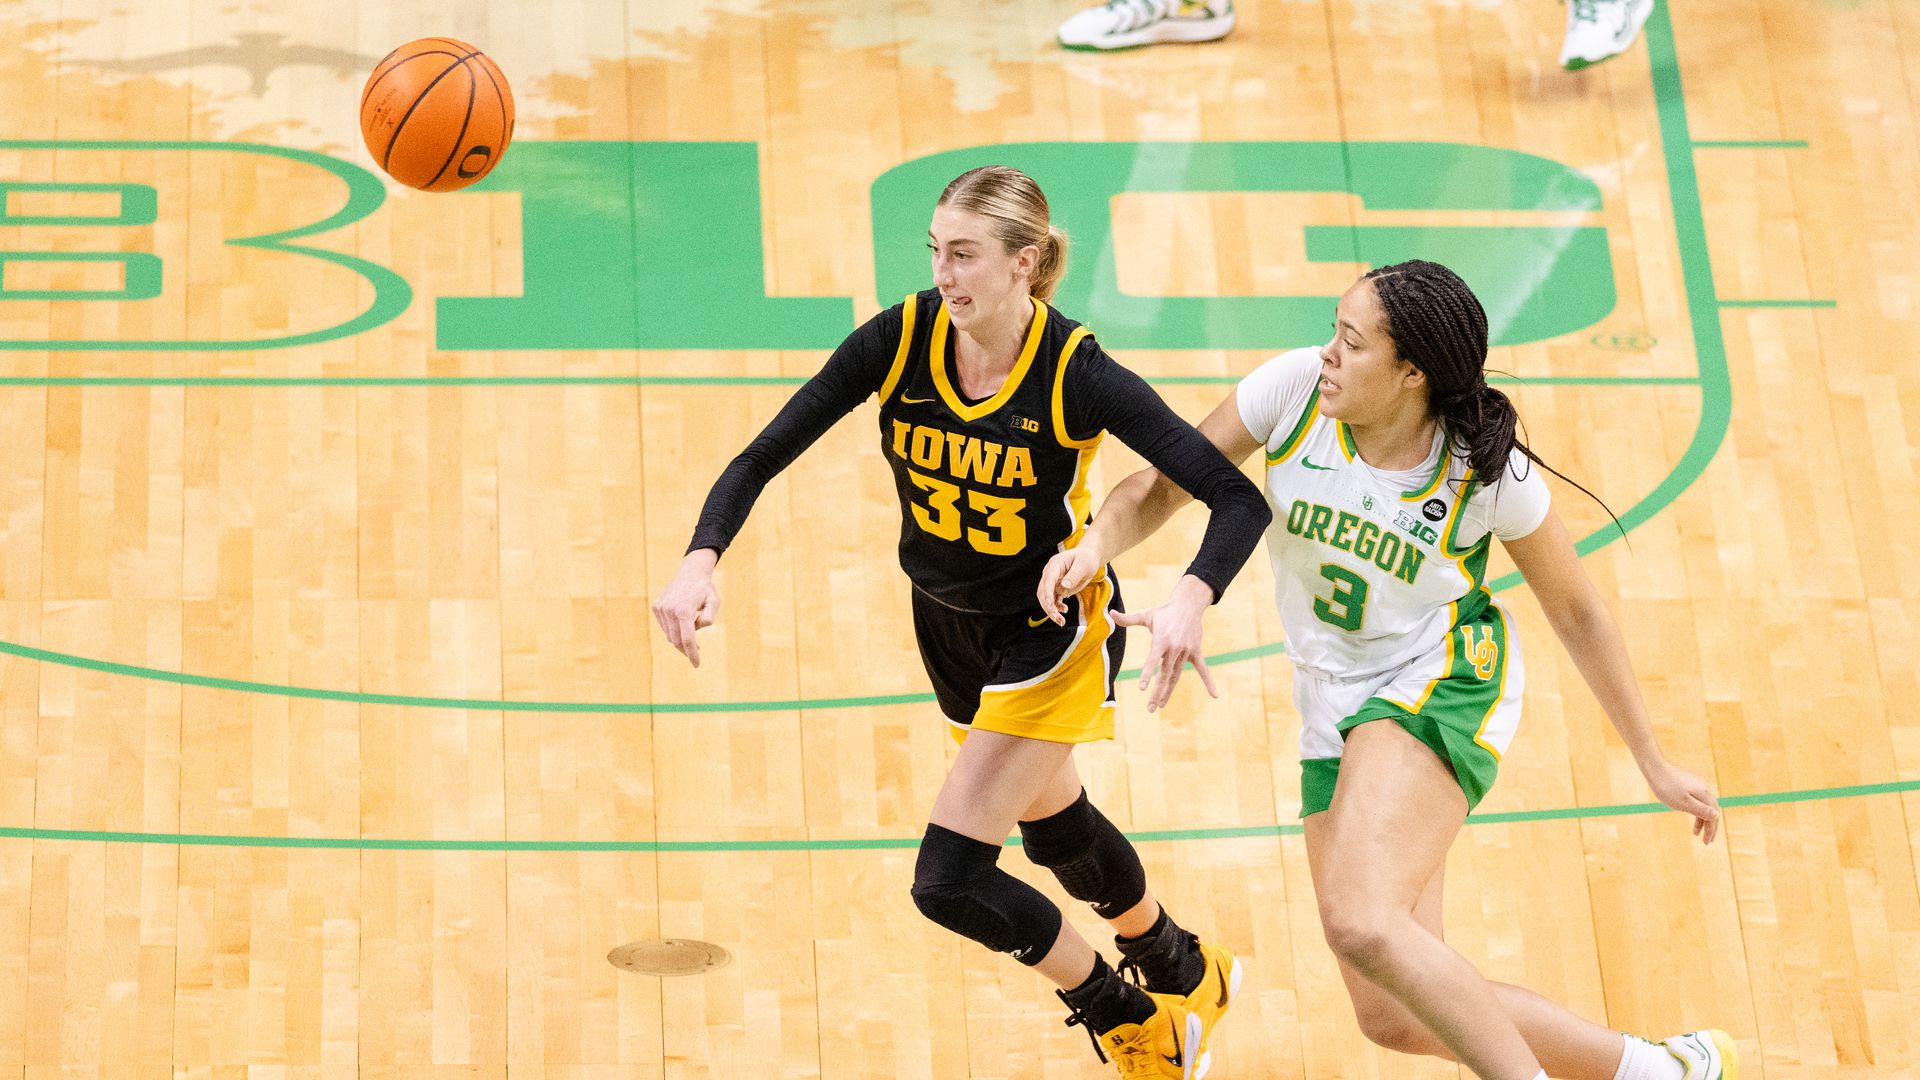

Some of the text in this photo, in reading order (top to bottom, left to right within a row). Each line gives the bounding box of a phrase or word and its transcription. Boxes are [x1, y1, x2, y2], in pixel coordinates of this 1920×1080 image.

[893, 417, 1037, 488] IOWA
[907, 467, 1027, 556] 33
[1286, 499, 1426, 585] OREGON
[1313, 562, 1371, 632] 3
